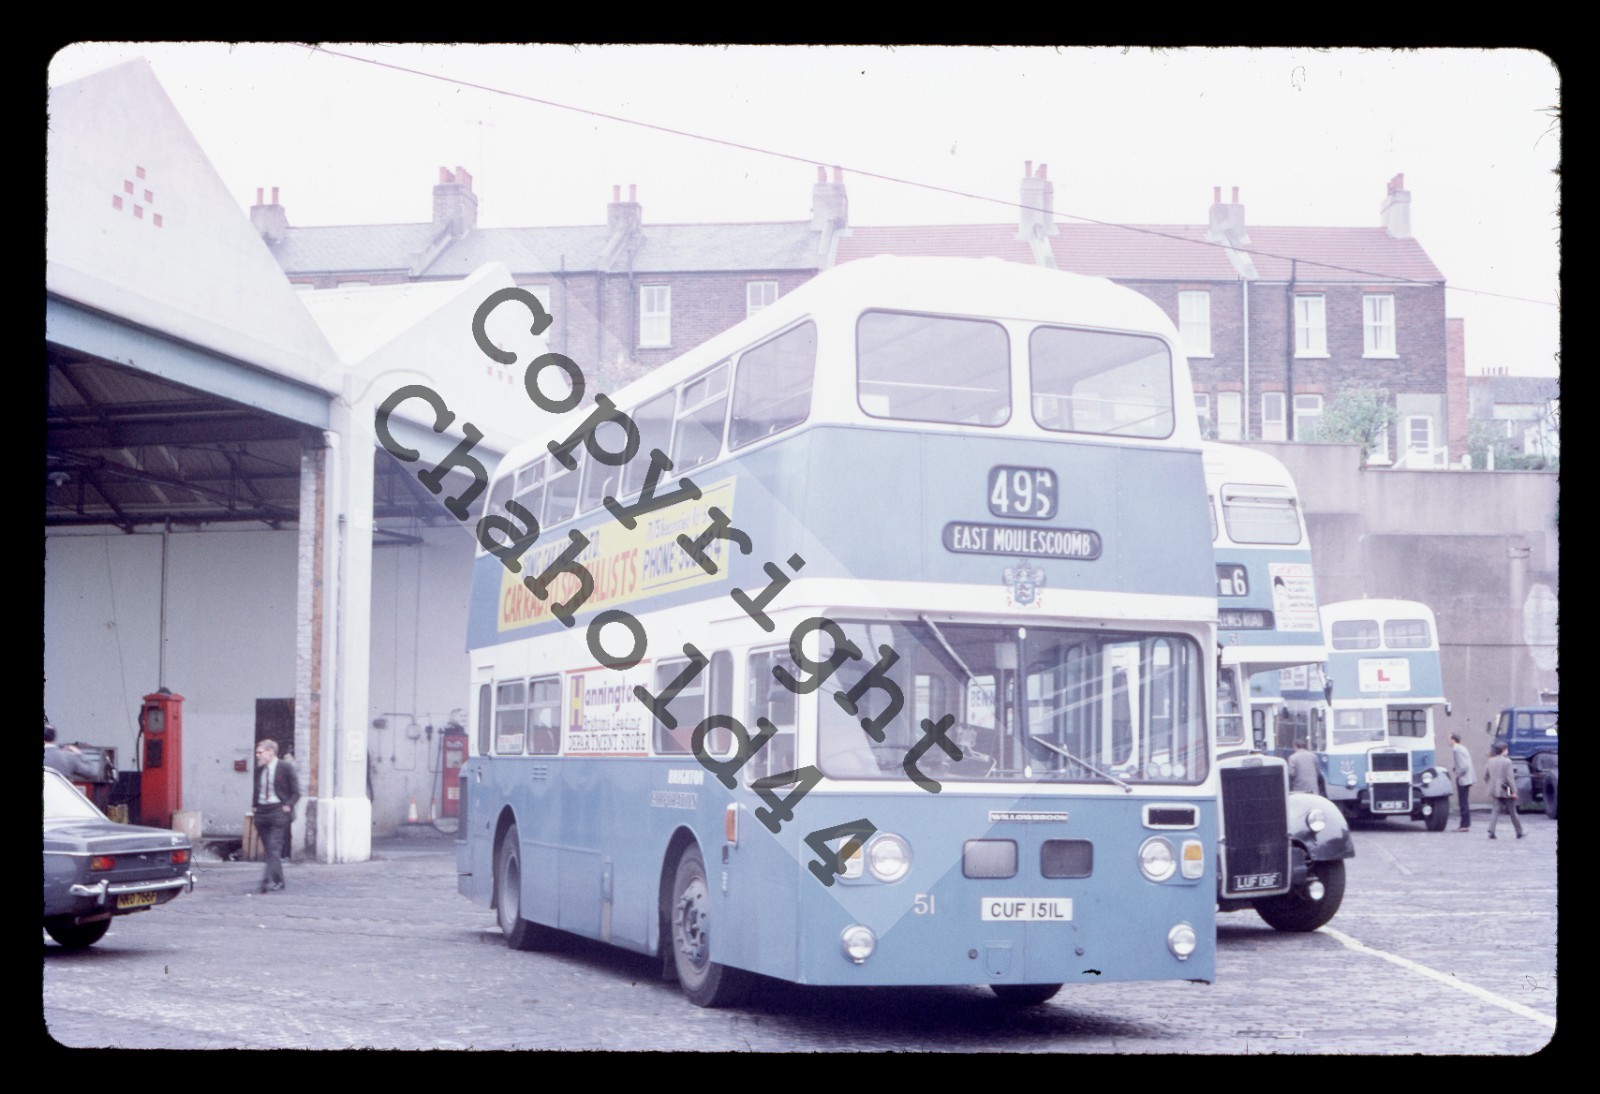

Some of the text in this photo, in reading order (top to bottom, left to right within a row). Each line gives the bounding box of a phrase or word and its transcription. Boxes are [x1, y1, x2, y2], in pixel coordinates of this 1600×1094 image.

[953, 526, 1091, 556] EAST MOULESCOOMB
[642, 540, 676, 580] PHONE
[503, 583, 523, 623] CAR
[1377, 669, 1391, 682] L
[568, 731, 646, 751] DEPARTMENT STORE
[991, 812, 1069, 822] WILLOWBROOK
[1237, 876, 1257, 888] LUF
[914, 894, 935, 914] 51
[991, 903, 1064, 918] CUF 151L
